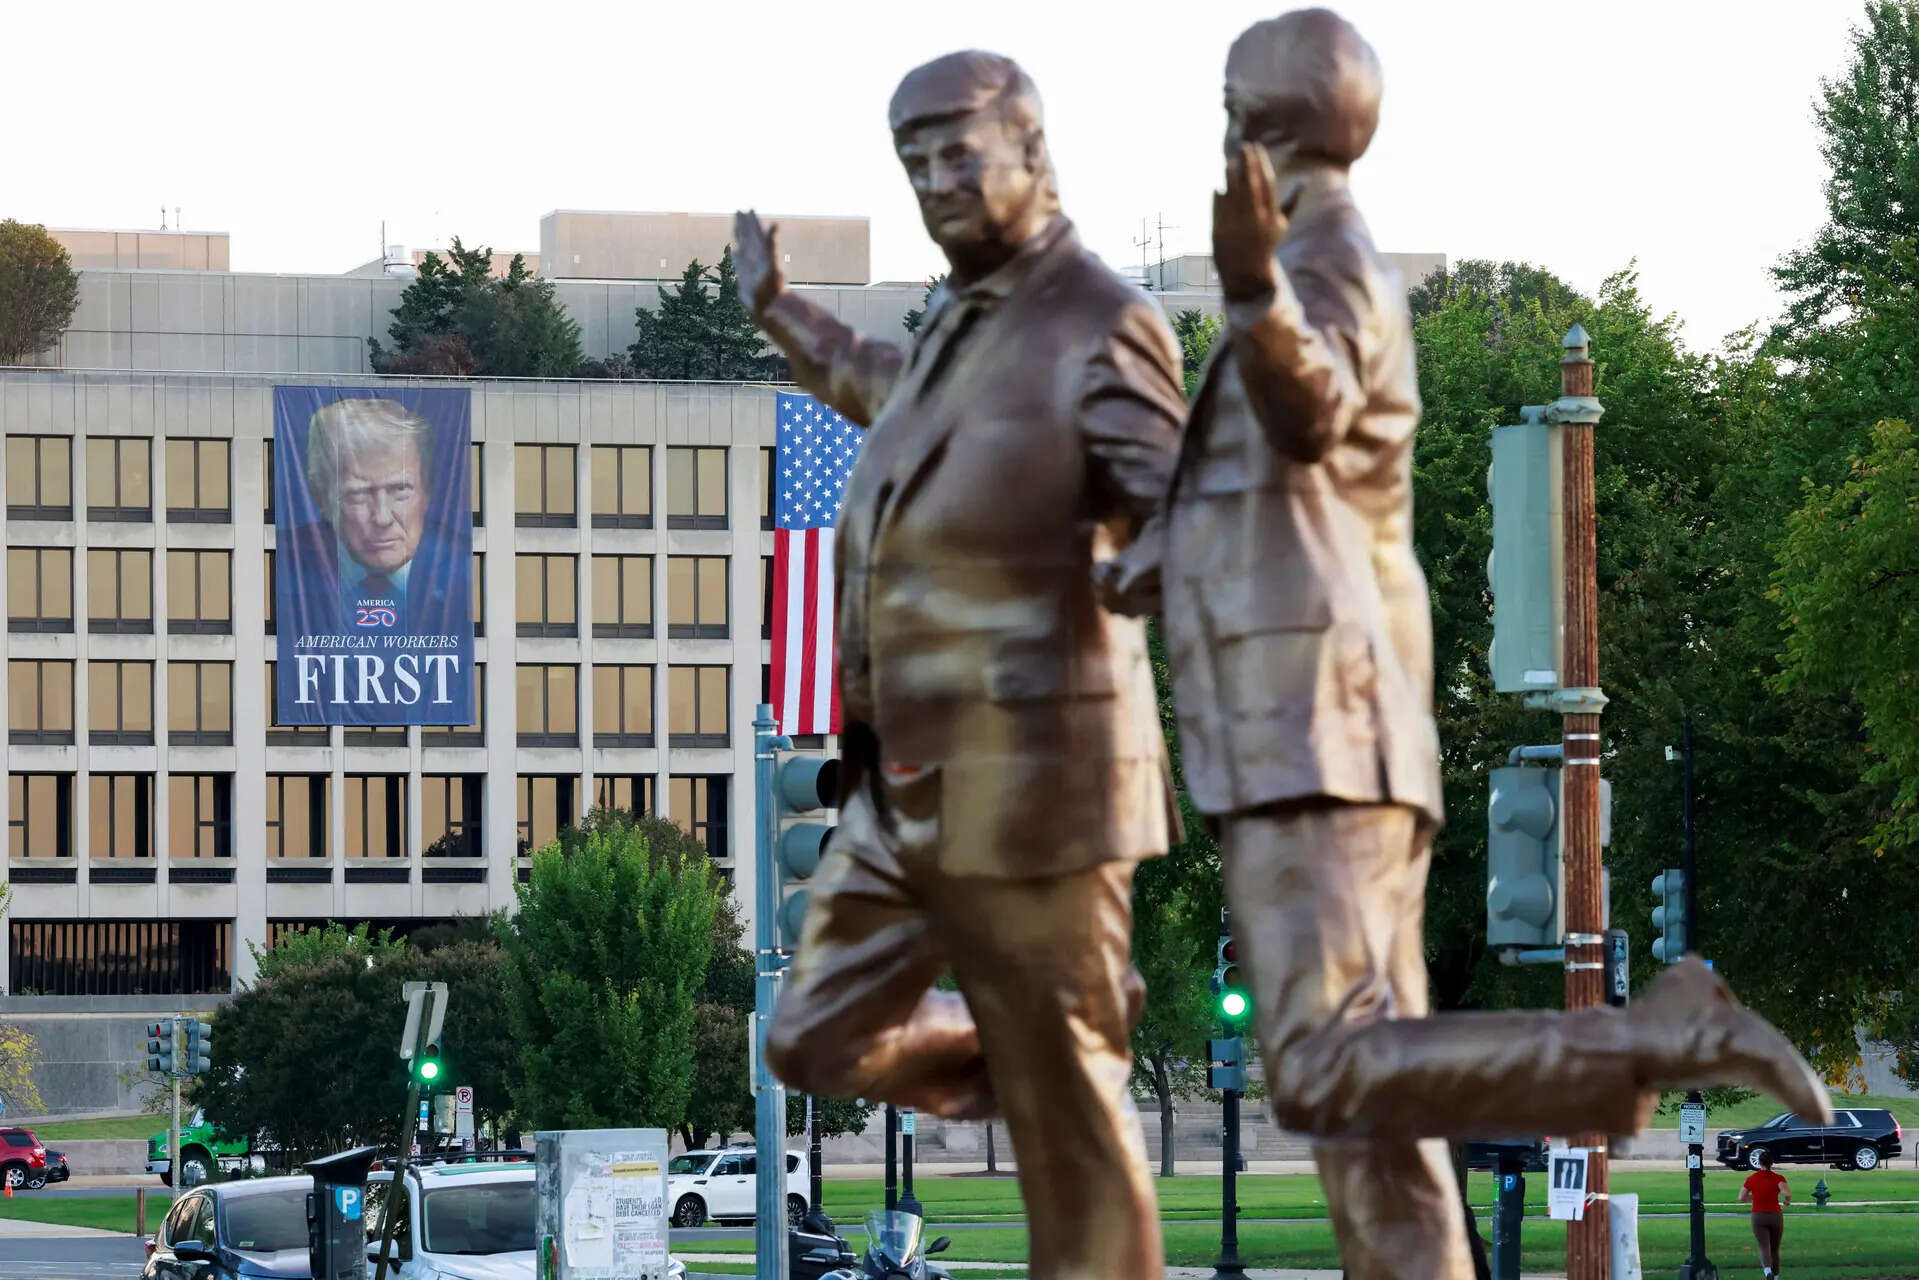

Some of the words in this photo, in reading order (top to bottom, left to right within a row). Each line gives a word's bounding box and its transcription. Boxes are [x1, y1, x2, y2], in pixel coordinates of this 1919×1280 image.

[356, 599, 395, 607] AMERICA
[356, 608, 397, 627] 250
[295, 635, 378, 649] AMERICAN
[383, 635, 458, 649] WORKERS
[294, 653, 459, 704] FIRST
[1505, 1175, 1513, 1189] P
[342, 1189, 357, 1214] P
